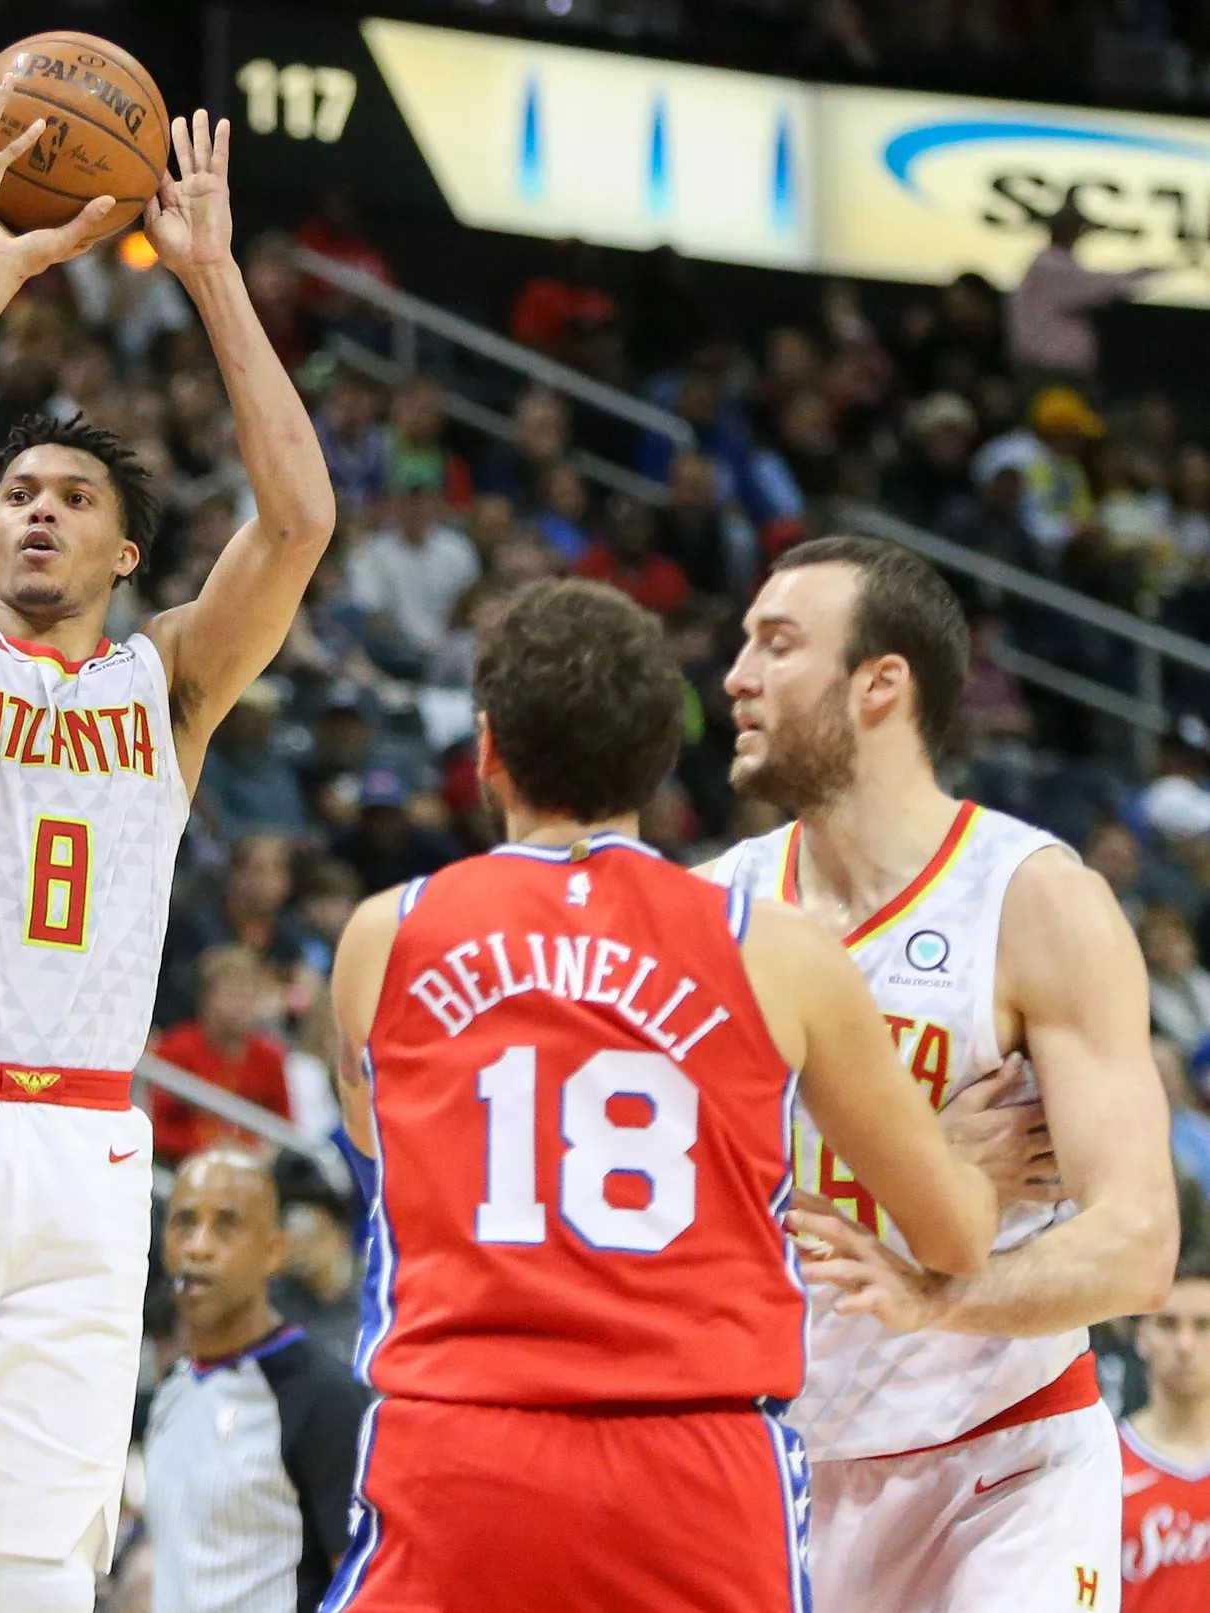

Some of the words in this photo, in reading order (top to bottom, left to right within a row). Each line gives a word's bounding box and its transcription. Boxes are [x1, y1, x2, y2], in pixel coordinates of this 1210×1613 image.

[234, 57, 357, 144] 117
[22, 814, 92, 952] 8
[408, 931, 731, 1063] BELINELLI
[887, 974, 954, 989] sharecare
[474, 1044, 700, 1254] 18
[1073, 1563, 1099, 1611] H
